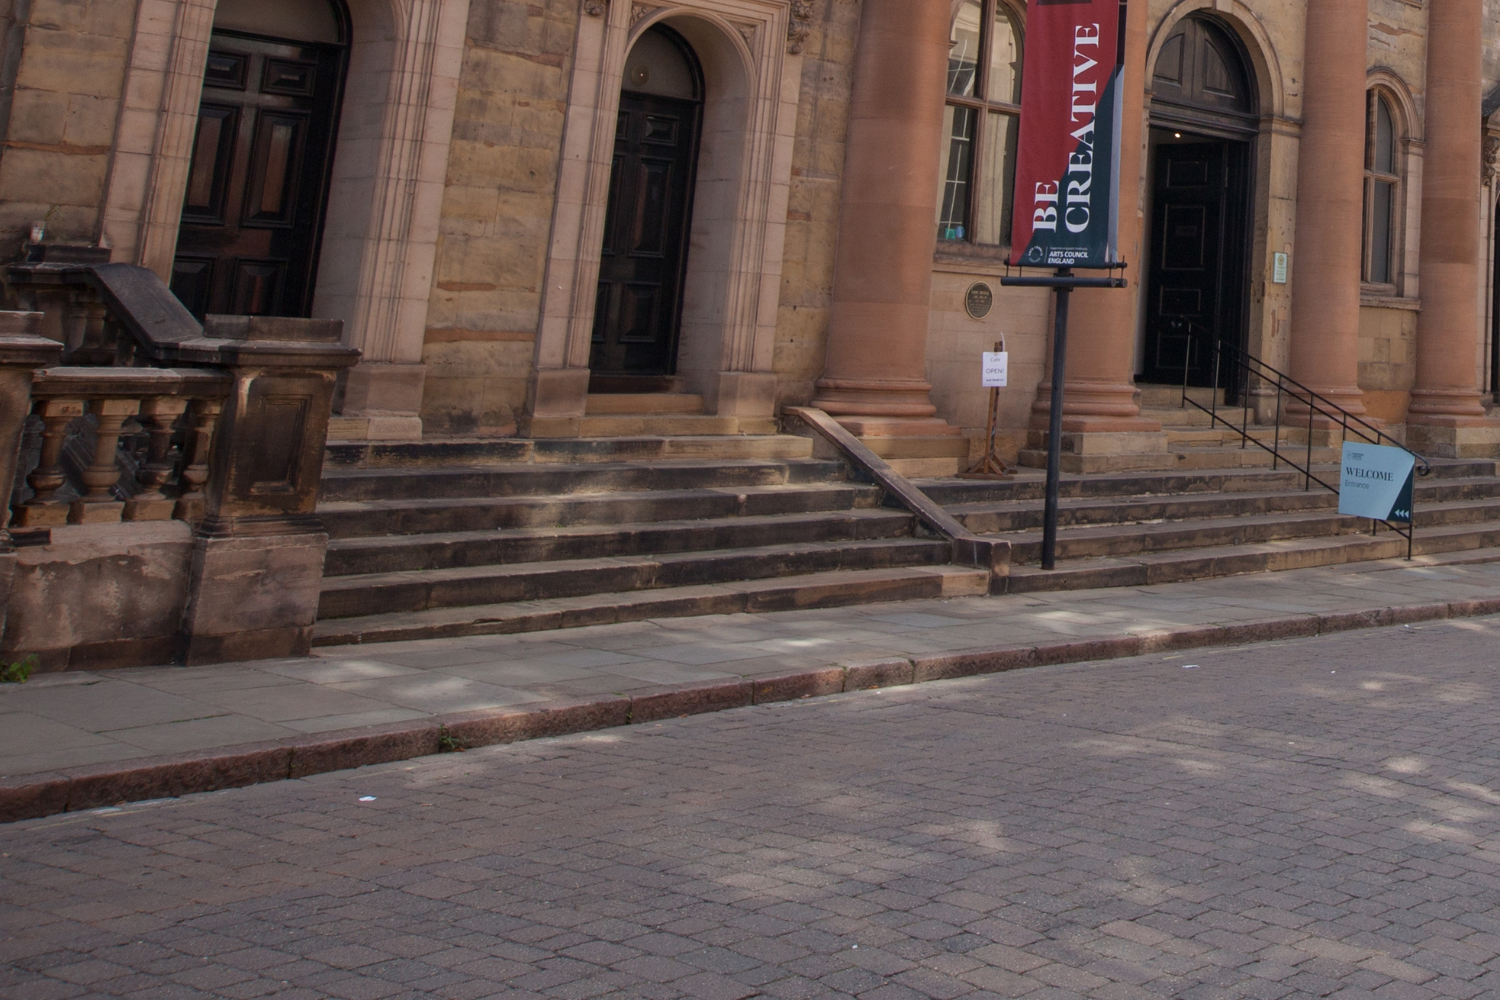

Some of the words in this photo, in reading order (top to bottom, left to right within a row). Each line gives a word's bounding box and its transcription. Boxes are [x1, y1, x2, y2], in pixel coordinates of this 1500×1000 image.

[1063, 23, 1101, 234] CREATIVE
[1032, 180, 1060, 233] BE
[1048, 257, 1075, 265] ENGLAND
[1049, 250, 1064, 258] ARTS
[1064, 251, 1089, 259] COUNCIL
[1345, 466, 1394, 482] WELCOME
[1344, 479, 1370, 490] Entrance
